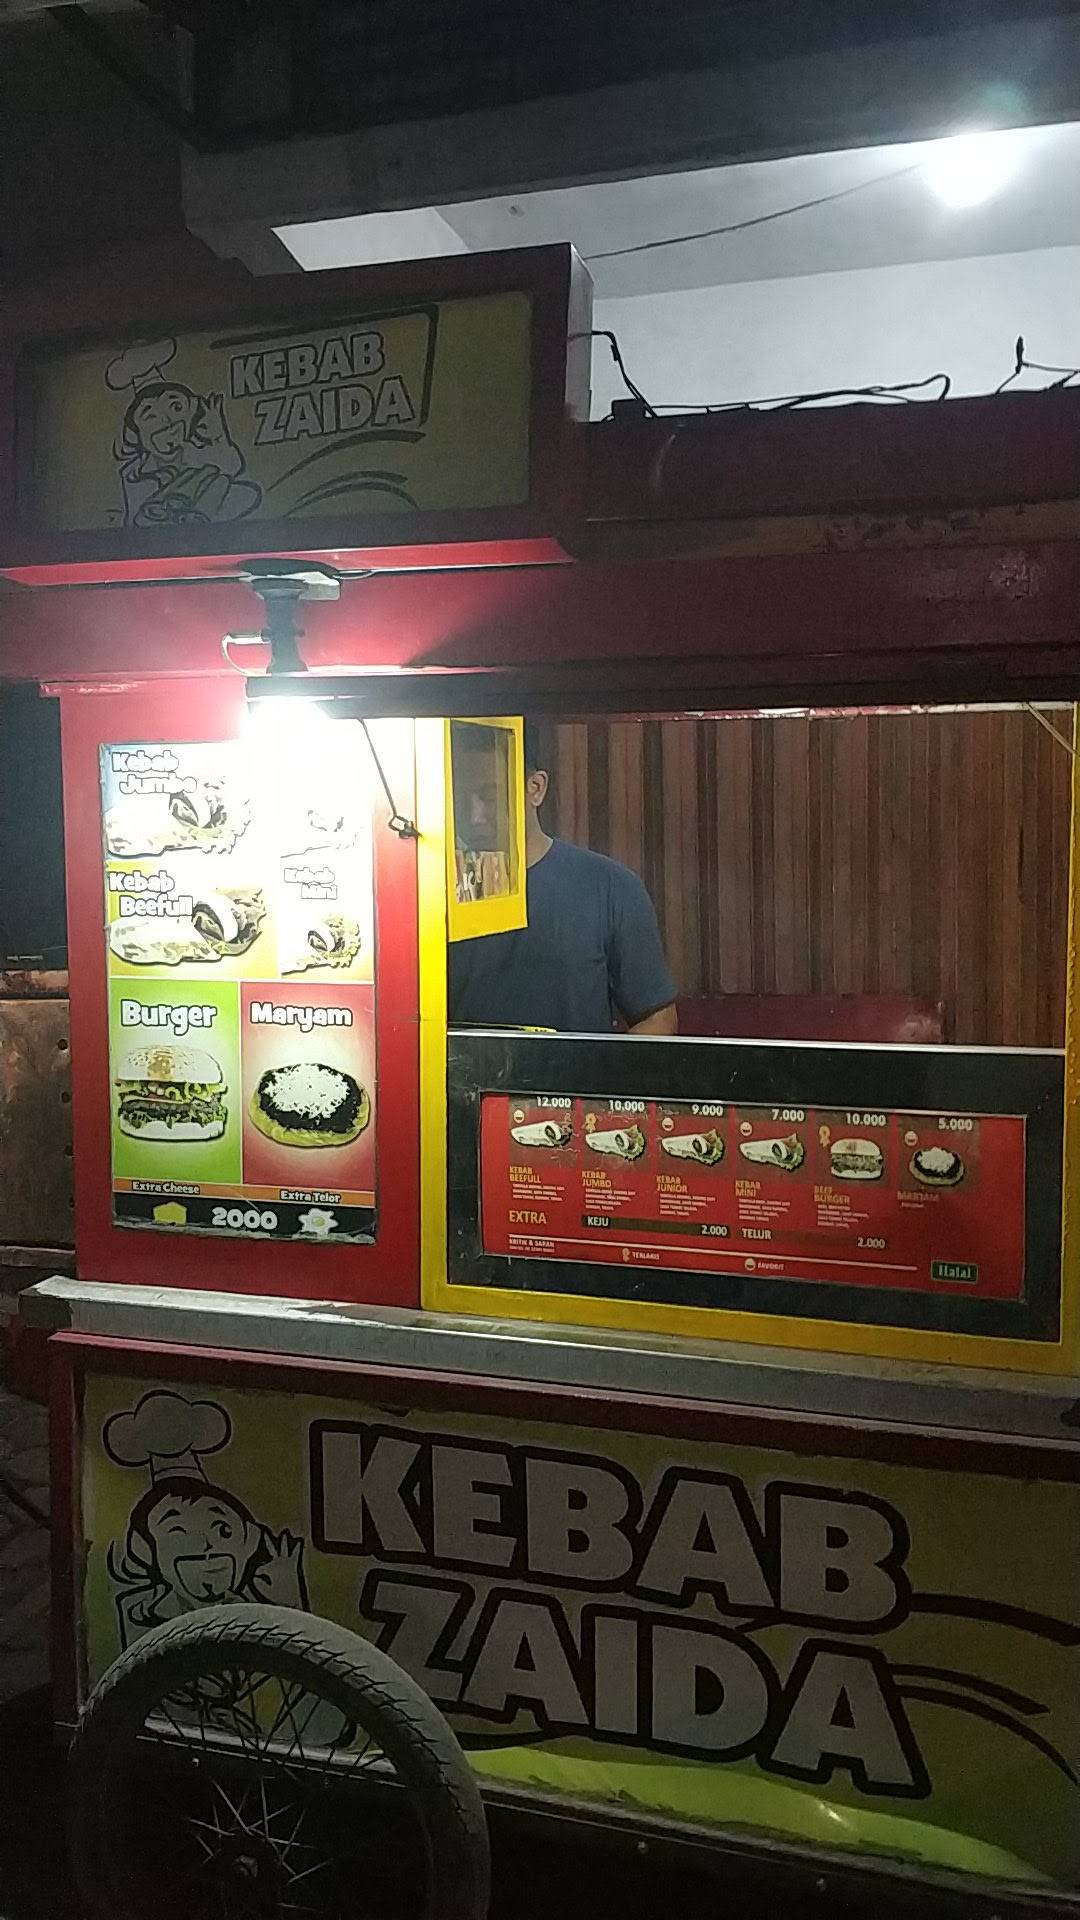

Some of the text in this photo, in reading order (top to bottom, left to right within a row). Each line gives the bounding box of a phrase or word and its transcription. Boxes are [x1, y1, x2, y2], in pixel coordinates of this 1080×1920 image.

[231, 332, 385, 399] KEBAB
[253, 376, 417, 446] ZAIDA
[112, 750, 179, 772] Kebab
[109, 870, 175, 893] Kebab
[119, 893, 193, 917] Beefull
[121, 1000, 217, 1036] Burger
[250, 1001, 352, 1032] Maryam
[536, 1096, 571, 1108] 12.000
[609, 1099, 645, 1112] 10.000
[692, 1104, 724, 1117] 9.000
[771, 1109, 805, 1122] 7.000
[846, 1113, 886, 1126] 10.000
[938, 1118, 973, 1131] 5.000
[132, 1181, 200, 1194] Extra Cheese
[656, 1183, 688, 1193] JUNIOR
[281, 1190, 341, 1203] Extra Telor
[211, 1206, 278, 1229] 2000
[509, 1211, 546, 1225] EXTRA
[587, 1216, 609, 1227] KEJU
[701, 1225, 728, 1236] 2.000
[741, 1228, 772, 1240] TELUR
[857, 1237, 886, 1249] 2.000
[308, 1418, 911, 1632] KEBAB
[361, 1570, 932, 1797] ZAIDA
